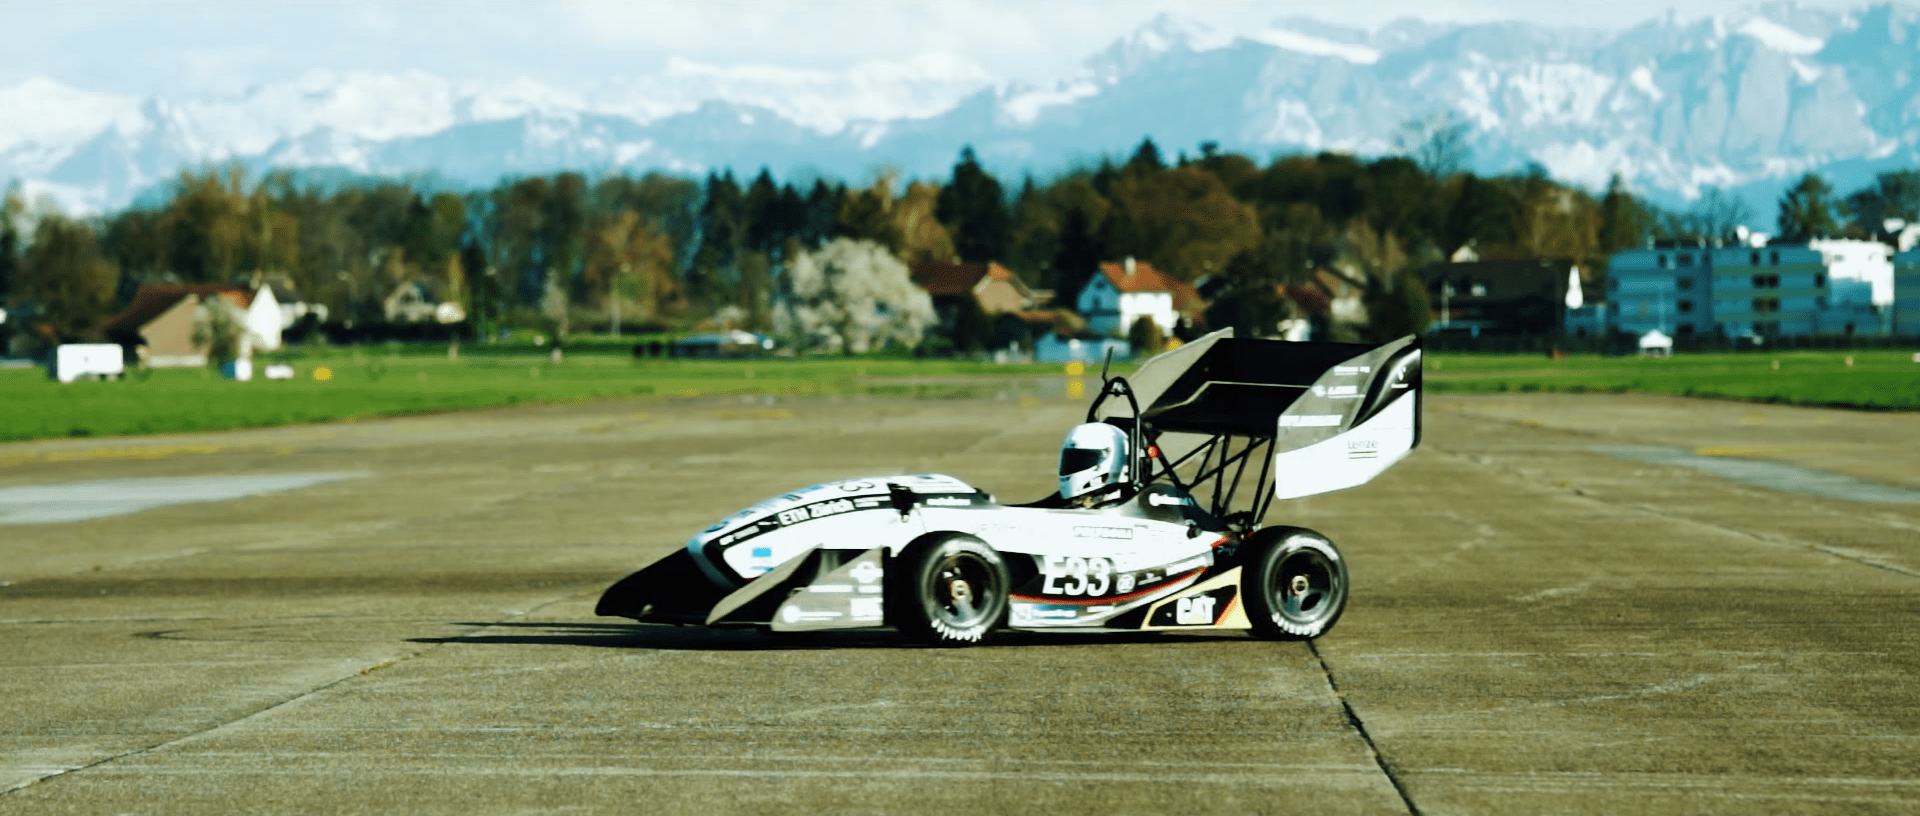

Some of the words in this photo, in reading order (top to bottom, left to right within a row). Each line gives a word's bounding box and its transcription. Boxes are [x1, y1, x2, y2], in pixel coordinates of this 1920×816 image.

[778, 507, 811, 527] ETH
[1042, 556, 1111, 597] E33
[1176, 594, 1217, 626] CAT
